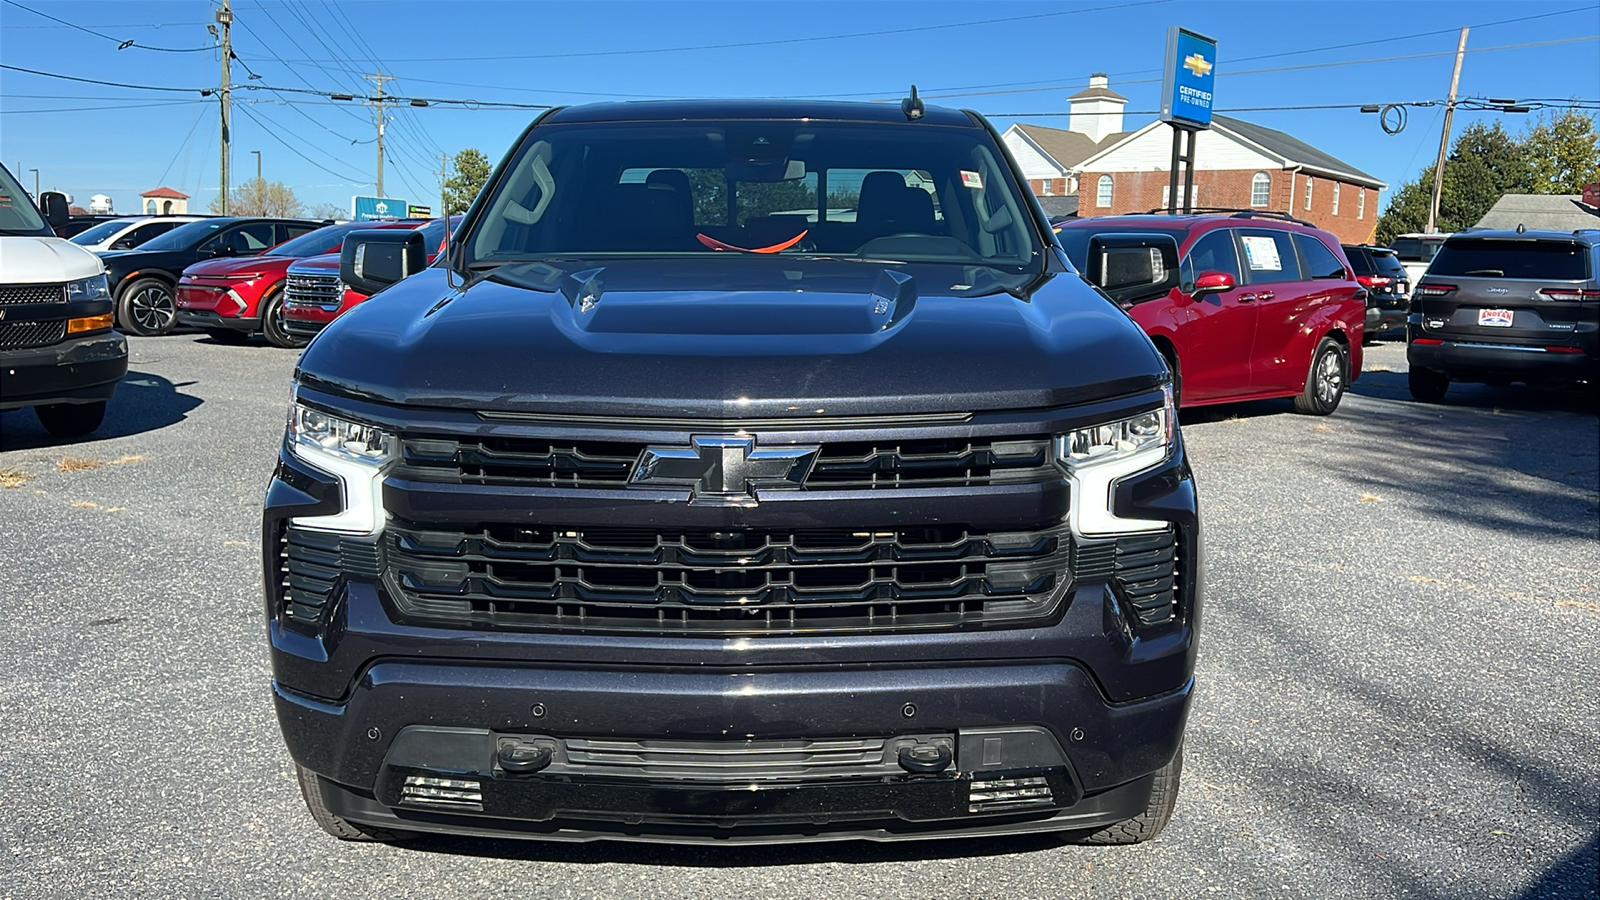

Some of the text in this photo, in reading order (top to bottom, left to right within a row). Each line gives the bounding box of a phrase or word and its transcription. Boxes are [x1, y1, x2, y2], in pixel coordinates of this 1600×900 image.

[1179, 85, 1211, 101] CERTIFIED
[1180, 94, 1210, 108] PRE-OWNED
[1486, 286, 1509, 295] Jeep
